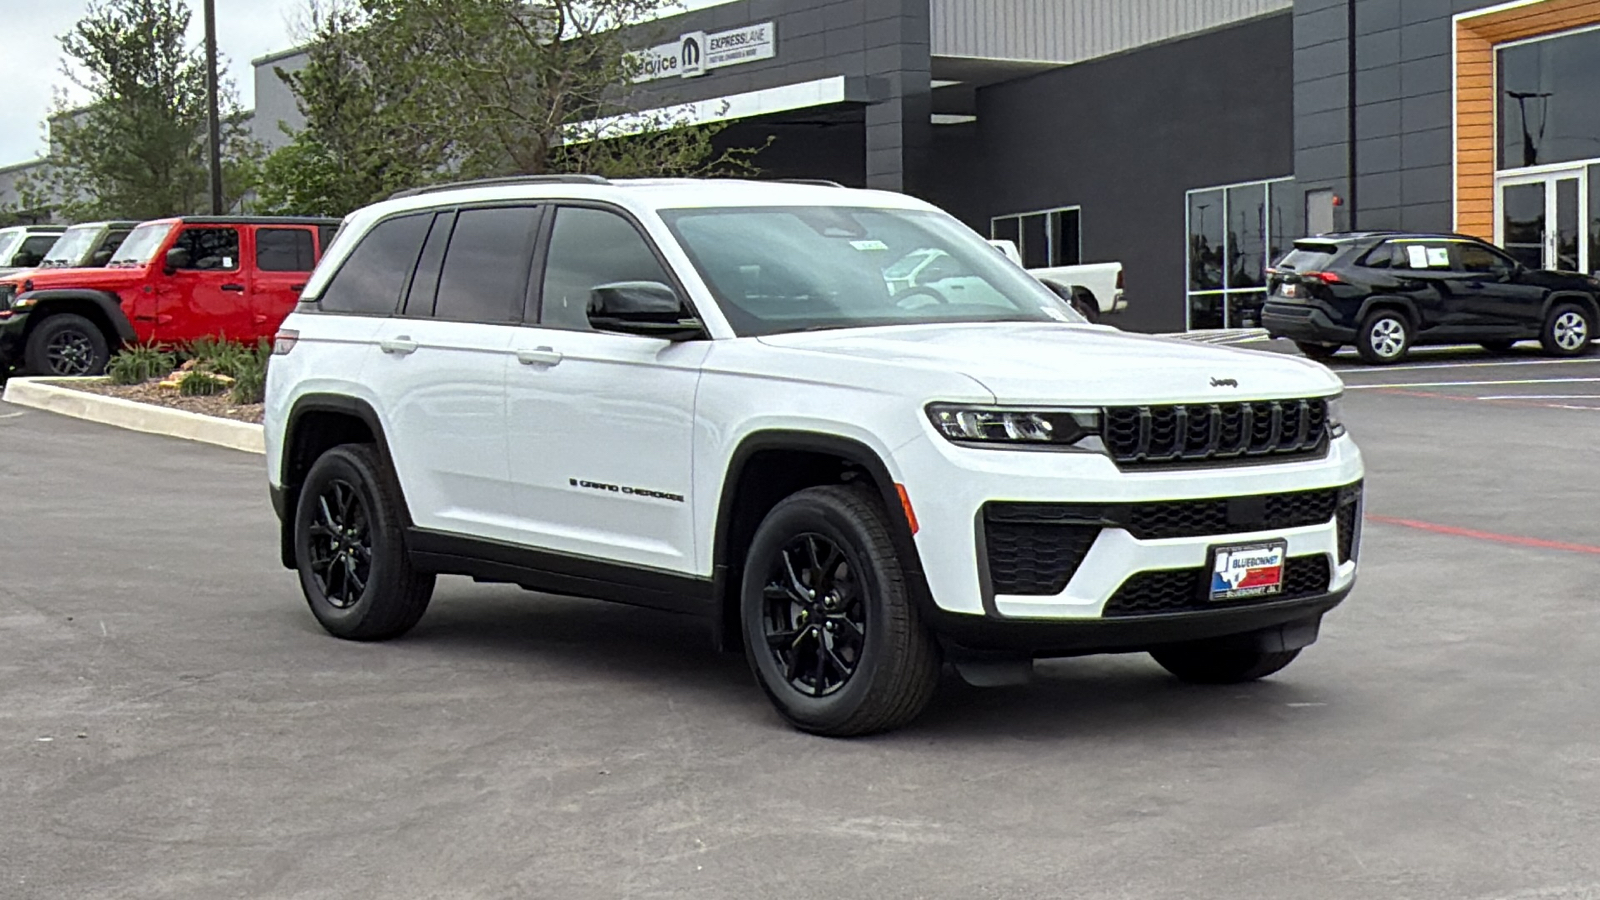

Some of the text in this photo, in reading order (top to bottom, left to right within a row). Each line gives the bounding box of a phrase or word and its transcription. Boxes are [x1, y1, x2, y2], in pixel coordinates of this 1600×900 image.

[629, 55, 677, 78] ervice
[1210, 376, 1238, 388] Jeep
[580, 480, 619, 492] GRAND
